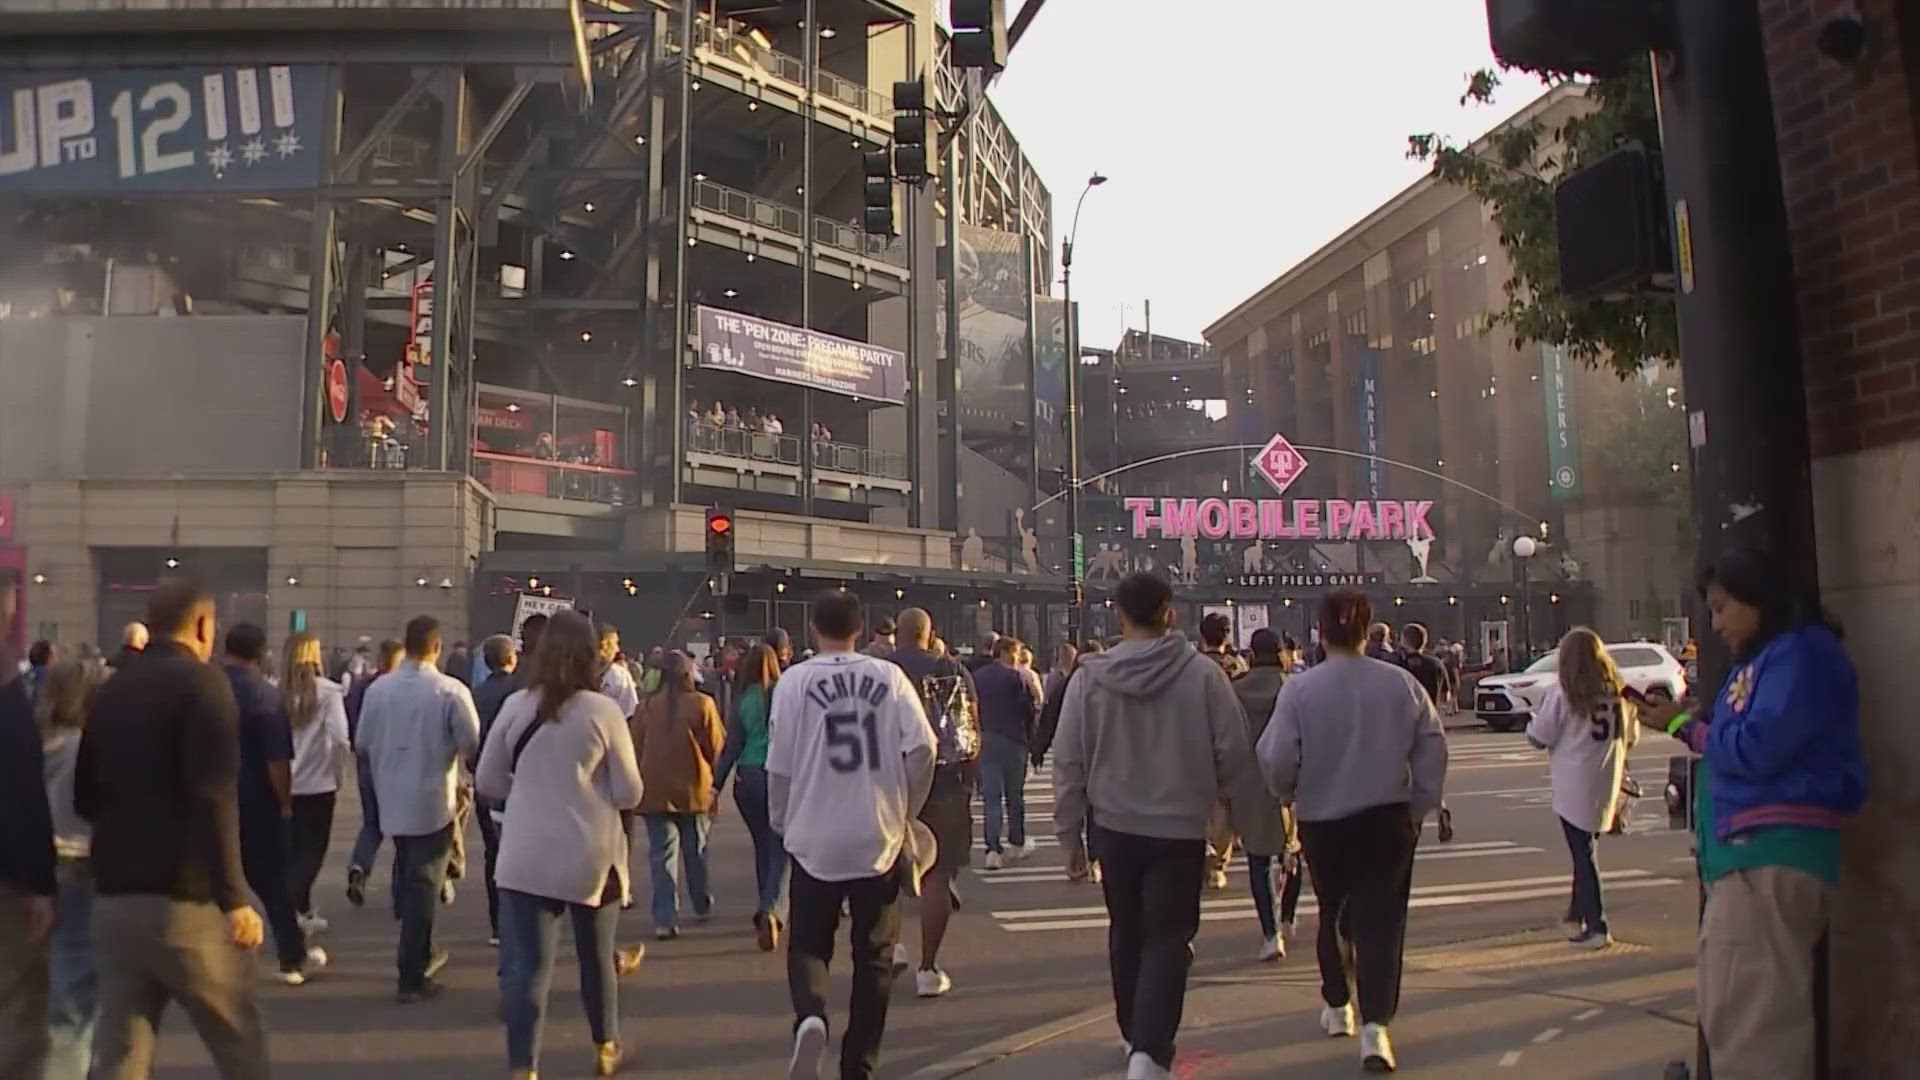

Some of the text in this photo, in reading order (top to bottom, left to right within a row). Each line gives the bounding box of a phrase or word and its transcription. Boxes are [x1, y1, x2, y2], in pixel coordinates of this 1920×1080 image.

[63, 137, 97, 161] TO
[715, 314, 740, 334] THE
[742, 319, 770, 341] 'PEN
[770, 327, 806, 348] ZONE:
[807, 334, 860, 361] PREGAME
[860, 347, 893, 368] PARTY
[1364, 379, 1379, 499] MARINERS
[1269, 450, 1293, 479] T
[1124, 498, 1434, 540] T-MOBILE PARK
[1240, 575, 1364, 586] LEFT FIELD GATE
[807, 672, 889, 710] ICHIRO
[825, 711, 880, 773] 51
[1591, 703, 1623, 742] 51
